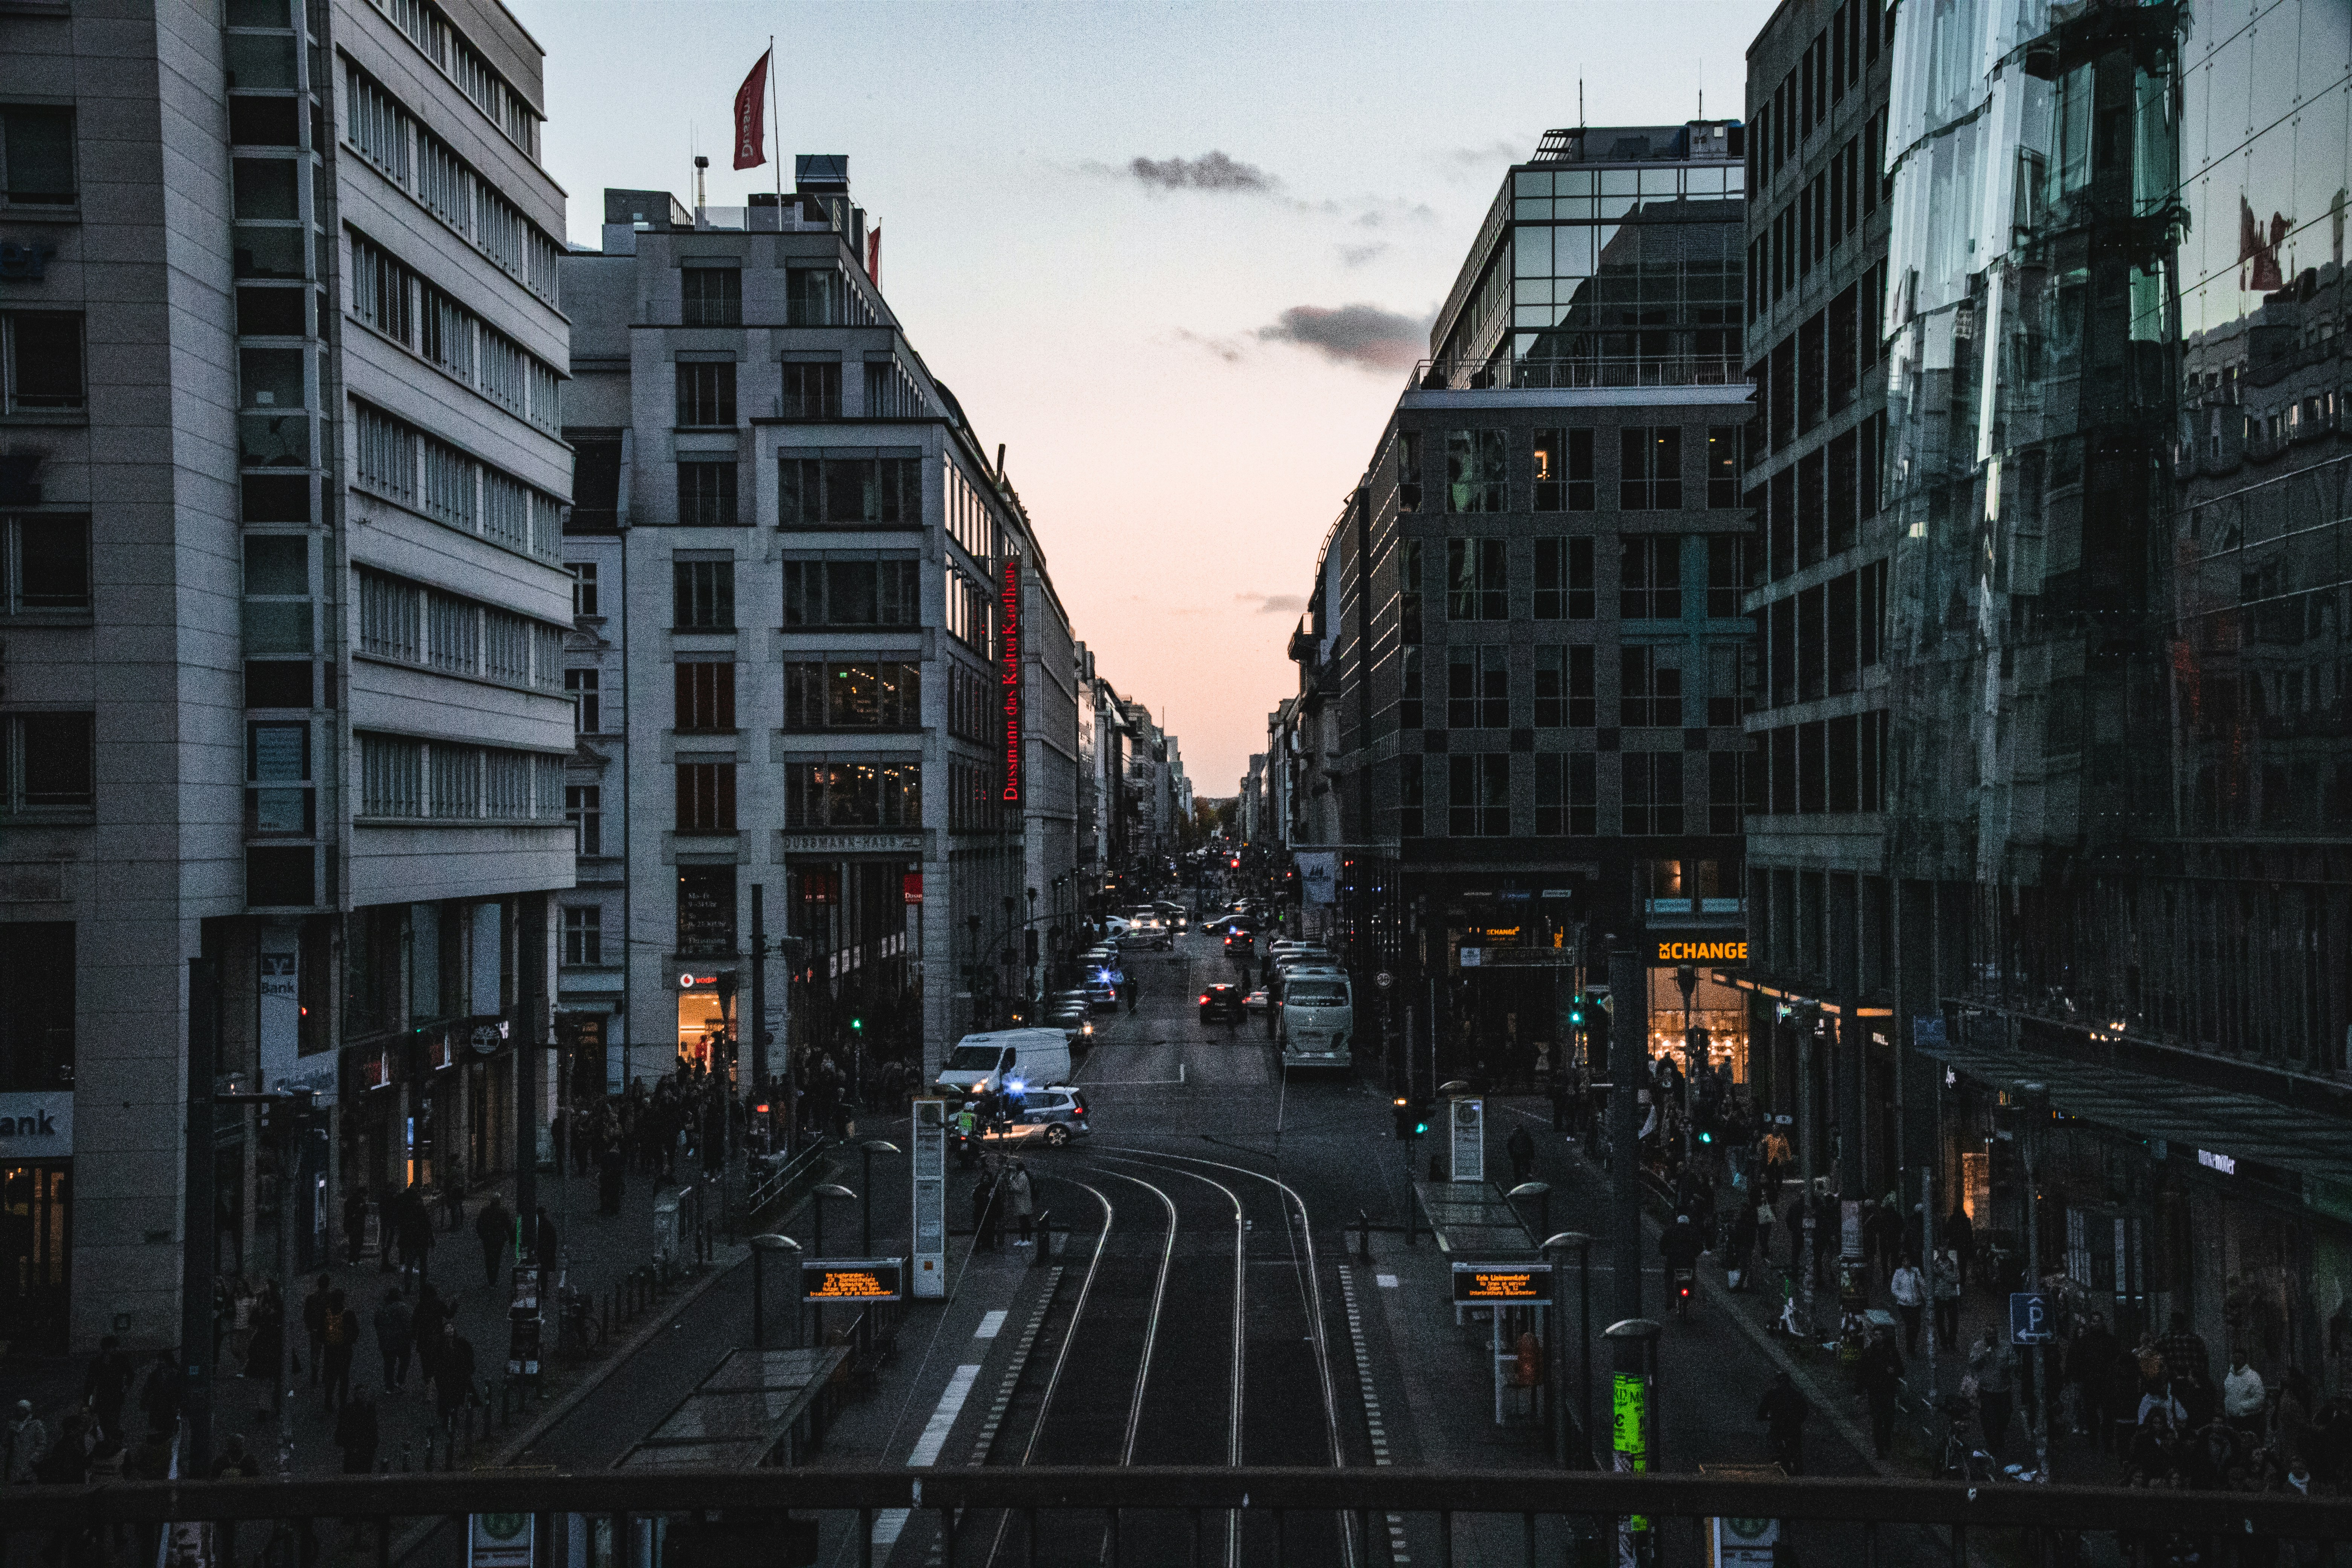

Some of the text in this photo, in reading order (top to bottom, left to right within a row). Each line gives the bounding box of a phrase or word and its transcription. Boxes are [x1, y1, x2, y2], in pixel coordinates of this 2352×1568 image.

[1004, 690, 1018, 715] das
[1003, 720, 1018, 801] Dussmann
[262, 982, 295, 994] Bank
[2029, 1307, 2044, 1331] P
